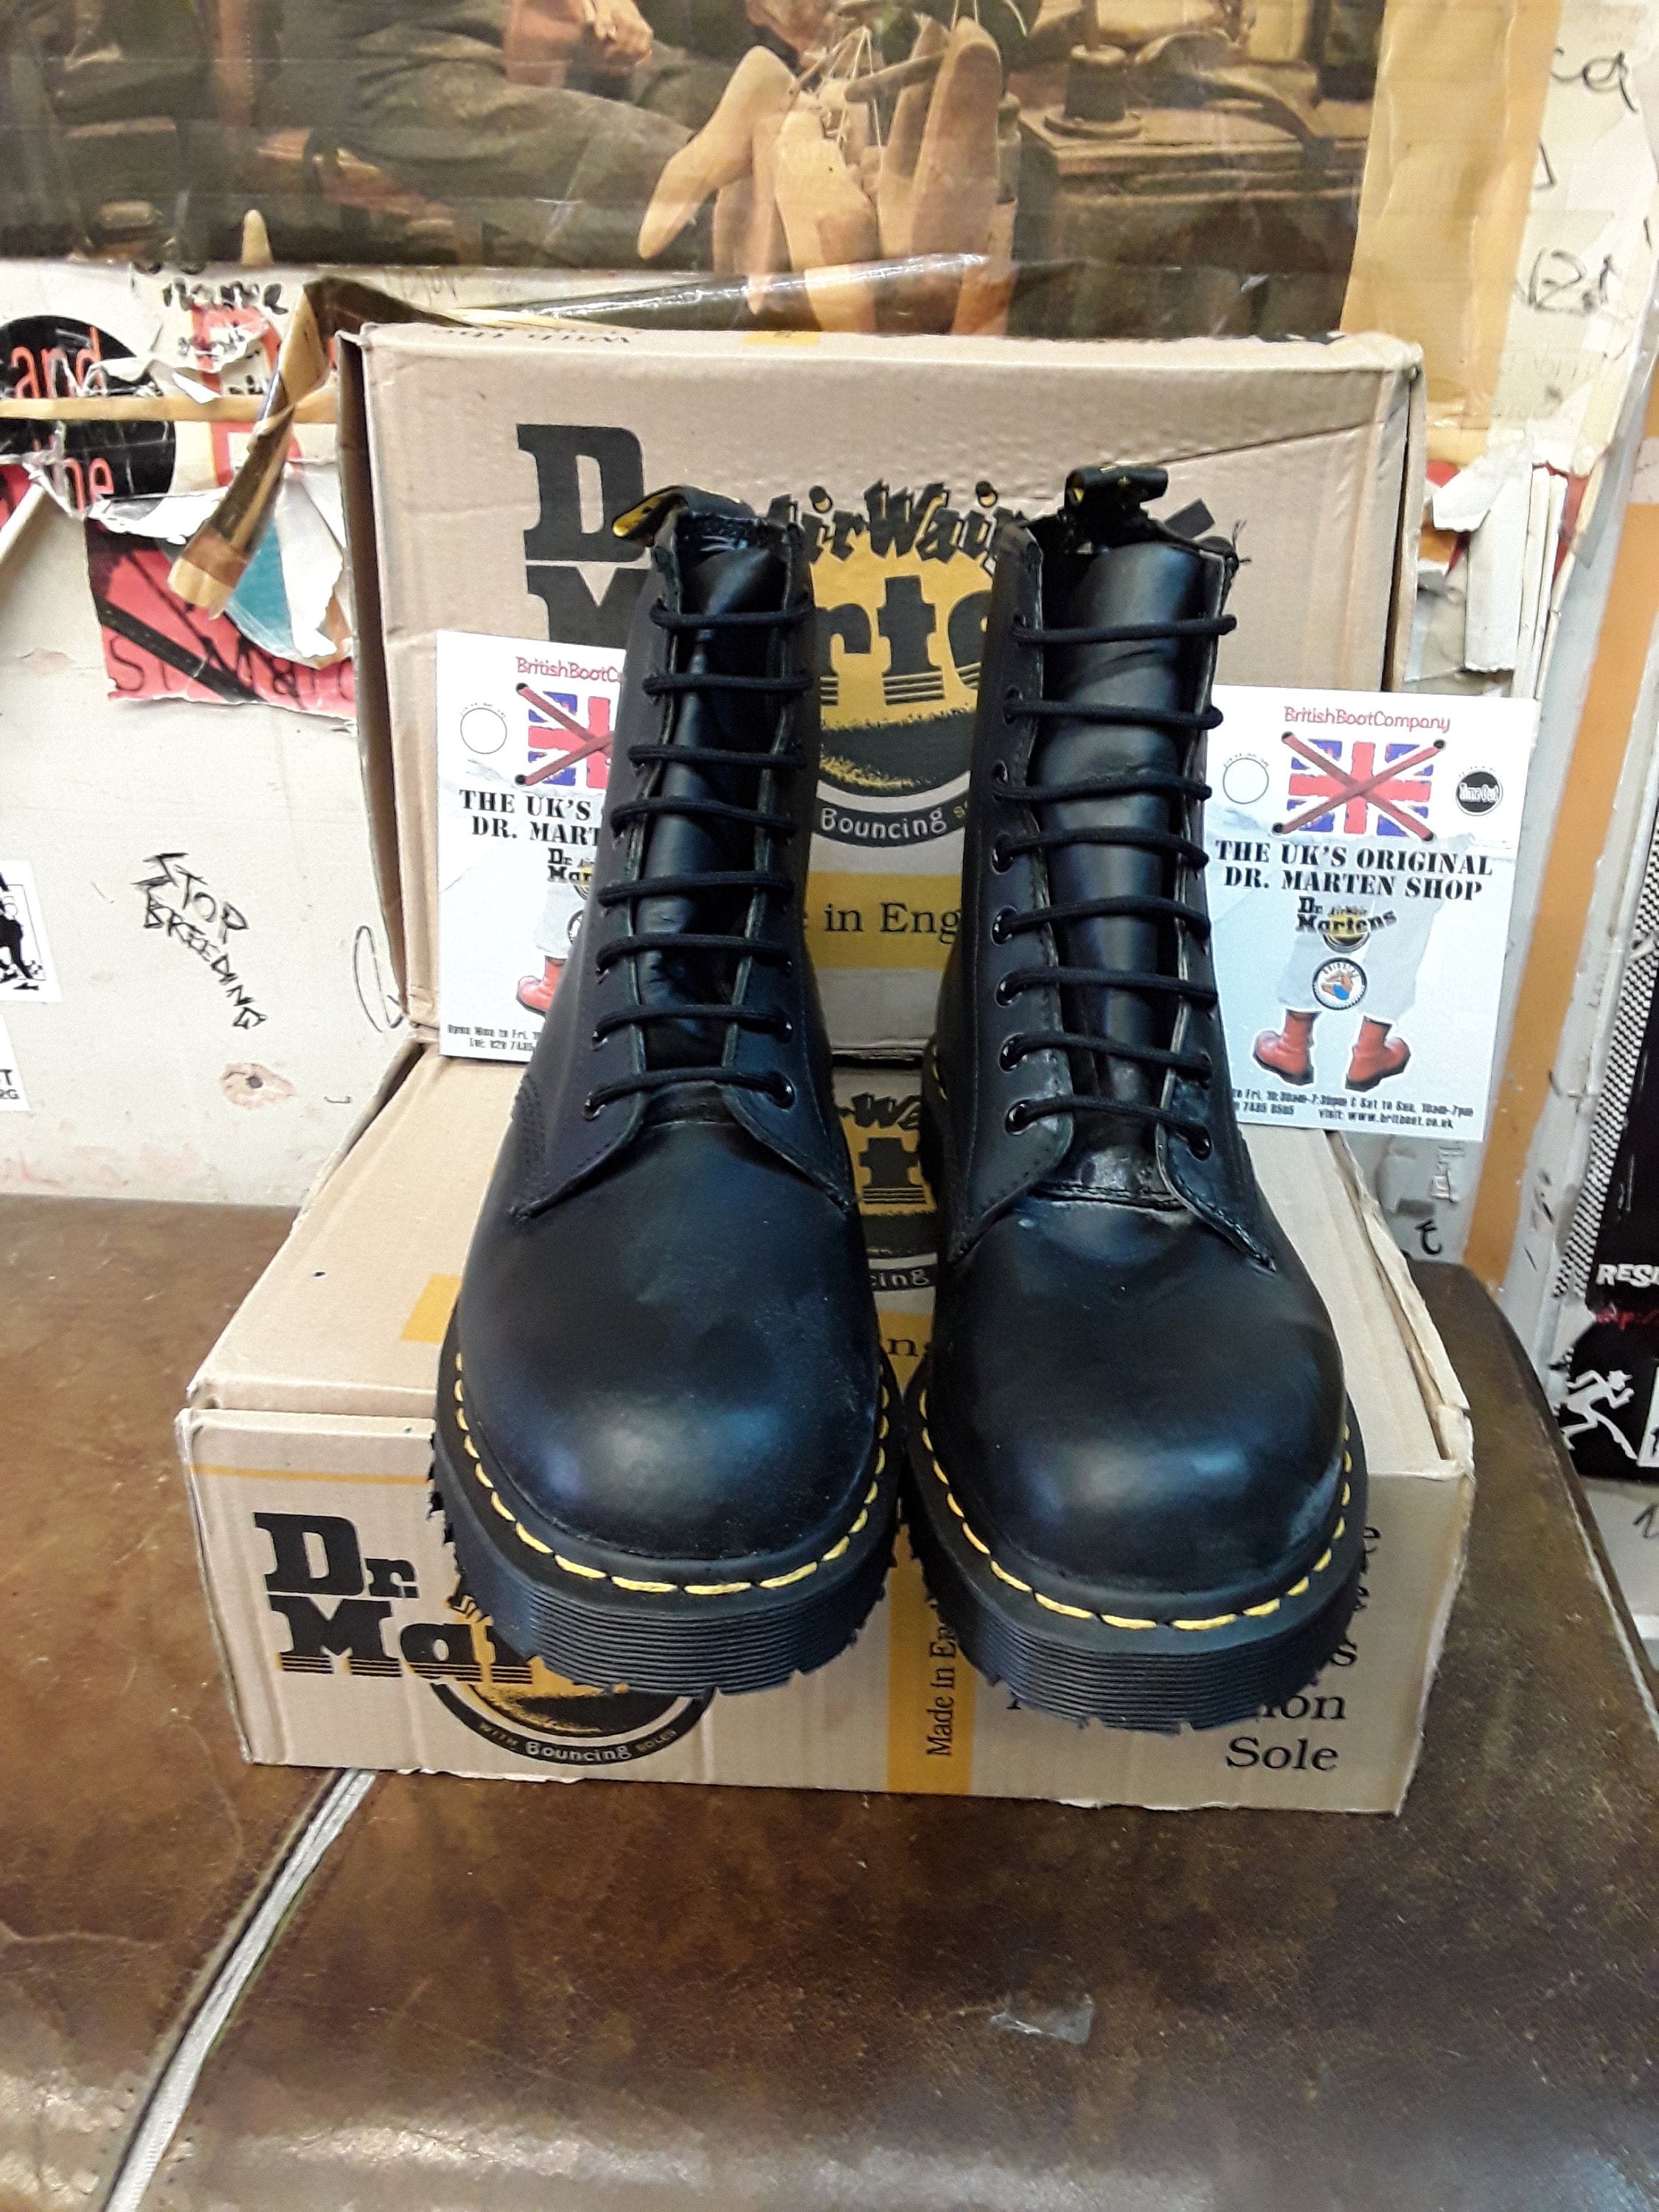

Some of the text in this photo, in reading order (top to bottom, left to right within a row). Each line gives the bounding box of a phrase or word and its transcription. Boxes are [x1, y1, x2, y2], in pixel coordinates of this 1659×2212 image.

[516, 423, 646, 562] D
[515, 655, 621, 683] BritishBootC
[1284, 706, 1451, 734] BritishBootCompany
[459, 789, 591, 821] THE UK'S
[472, 815, 599, 846] DR. MART
[821, 807, 947, 838] Bouncing
[1216, 840, 1493, 876] THE UK'S ORIGINAL
[1224, 866, 1483, 900] DR. MARTEN SHOP
[824, 902, 863, 932] in
[1295, 910, 1398, 934] Martens
[254, 1512, 420, 1599] Dr
[926, 1697, 954, 1756] Made
[524, 1741, 632, 1761] Bouncing
[1225, 1736, 1339, 1771] Sole
